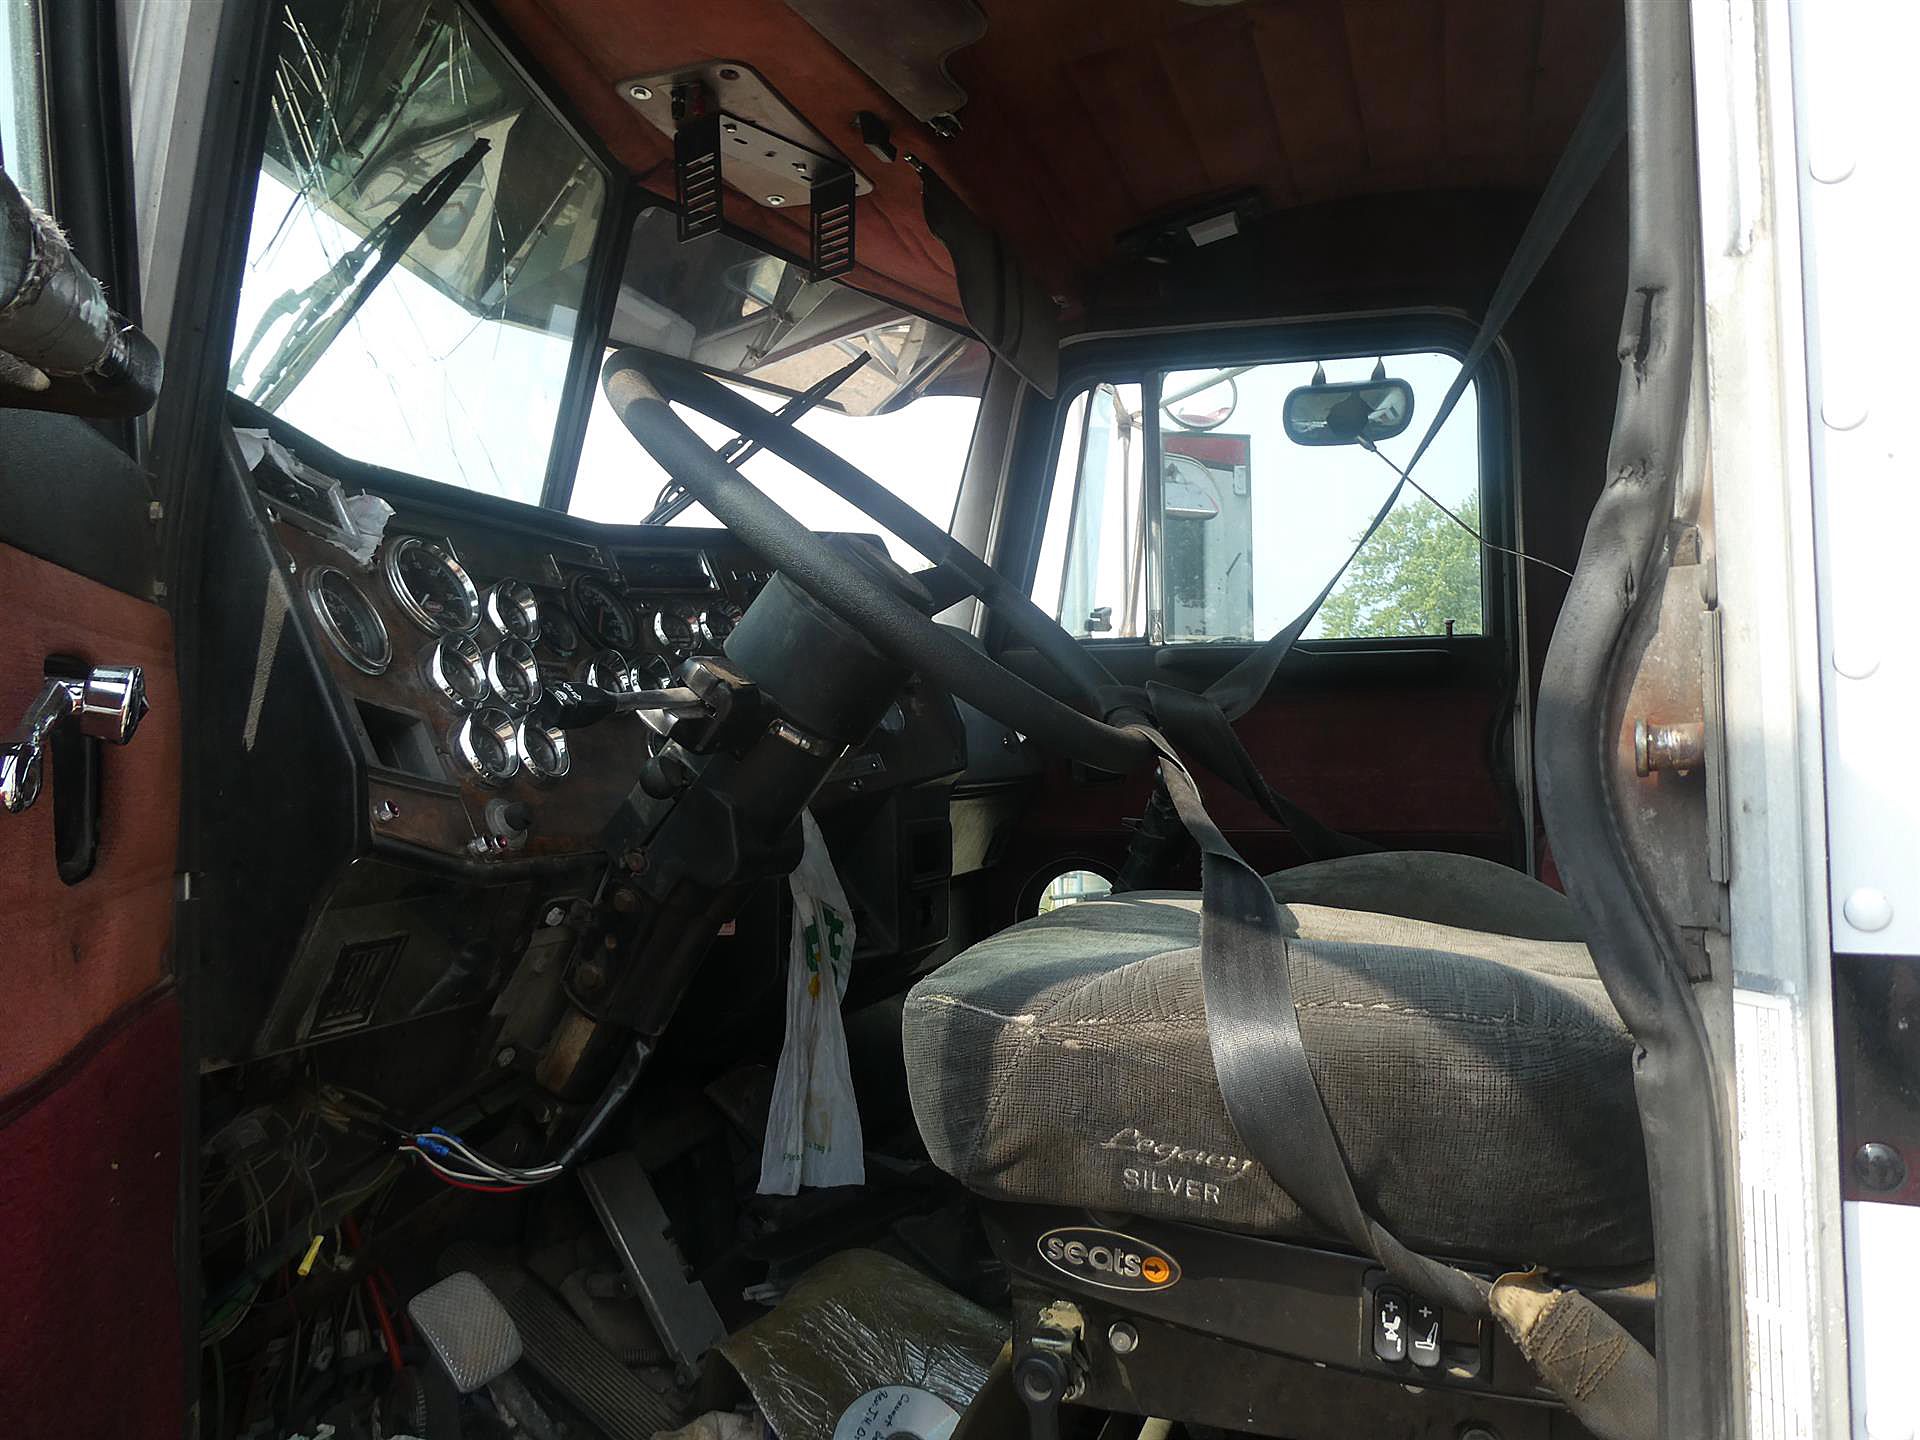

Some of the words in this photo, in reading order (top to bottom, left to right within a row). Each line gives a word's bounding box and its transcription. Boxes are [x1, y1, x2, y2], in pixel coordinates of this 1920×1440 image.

[1100, 1128, 1252, 1181] Legacy
[1122, 1168, 1221, 1204] SILVER
[1047, 1237, 1141, 1277] seats
